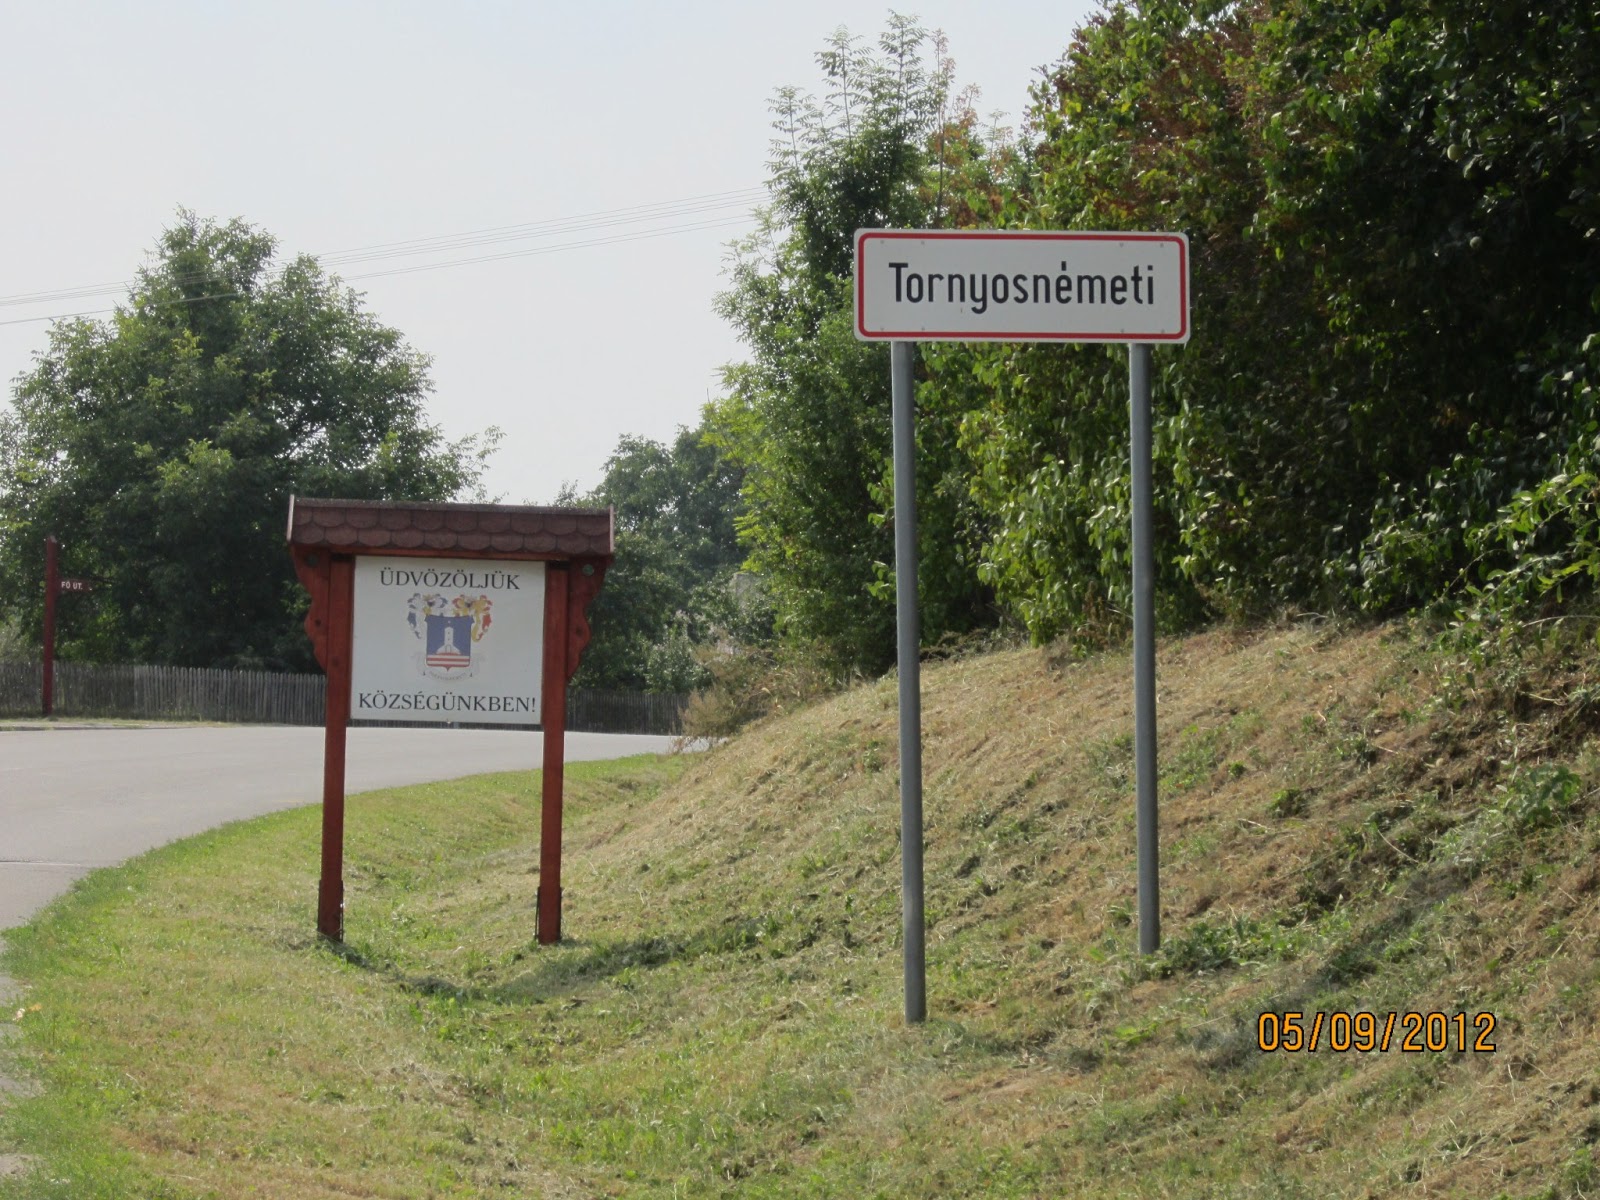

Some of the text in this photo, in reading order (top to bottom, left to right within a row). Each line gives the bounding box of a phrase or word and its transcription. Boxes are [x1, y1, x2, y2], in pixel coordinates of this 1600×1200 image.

[888, 261, 1154, 314] Tornyosnémeti
[380, 567, 520, 590] ÜDVÖZÖLJÜK
[358, 690, 536, 713] KÖZSÉGÜNKBEN!
